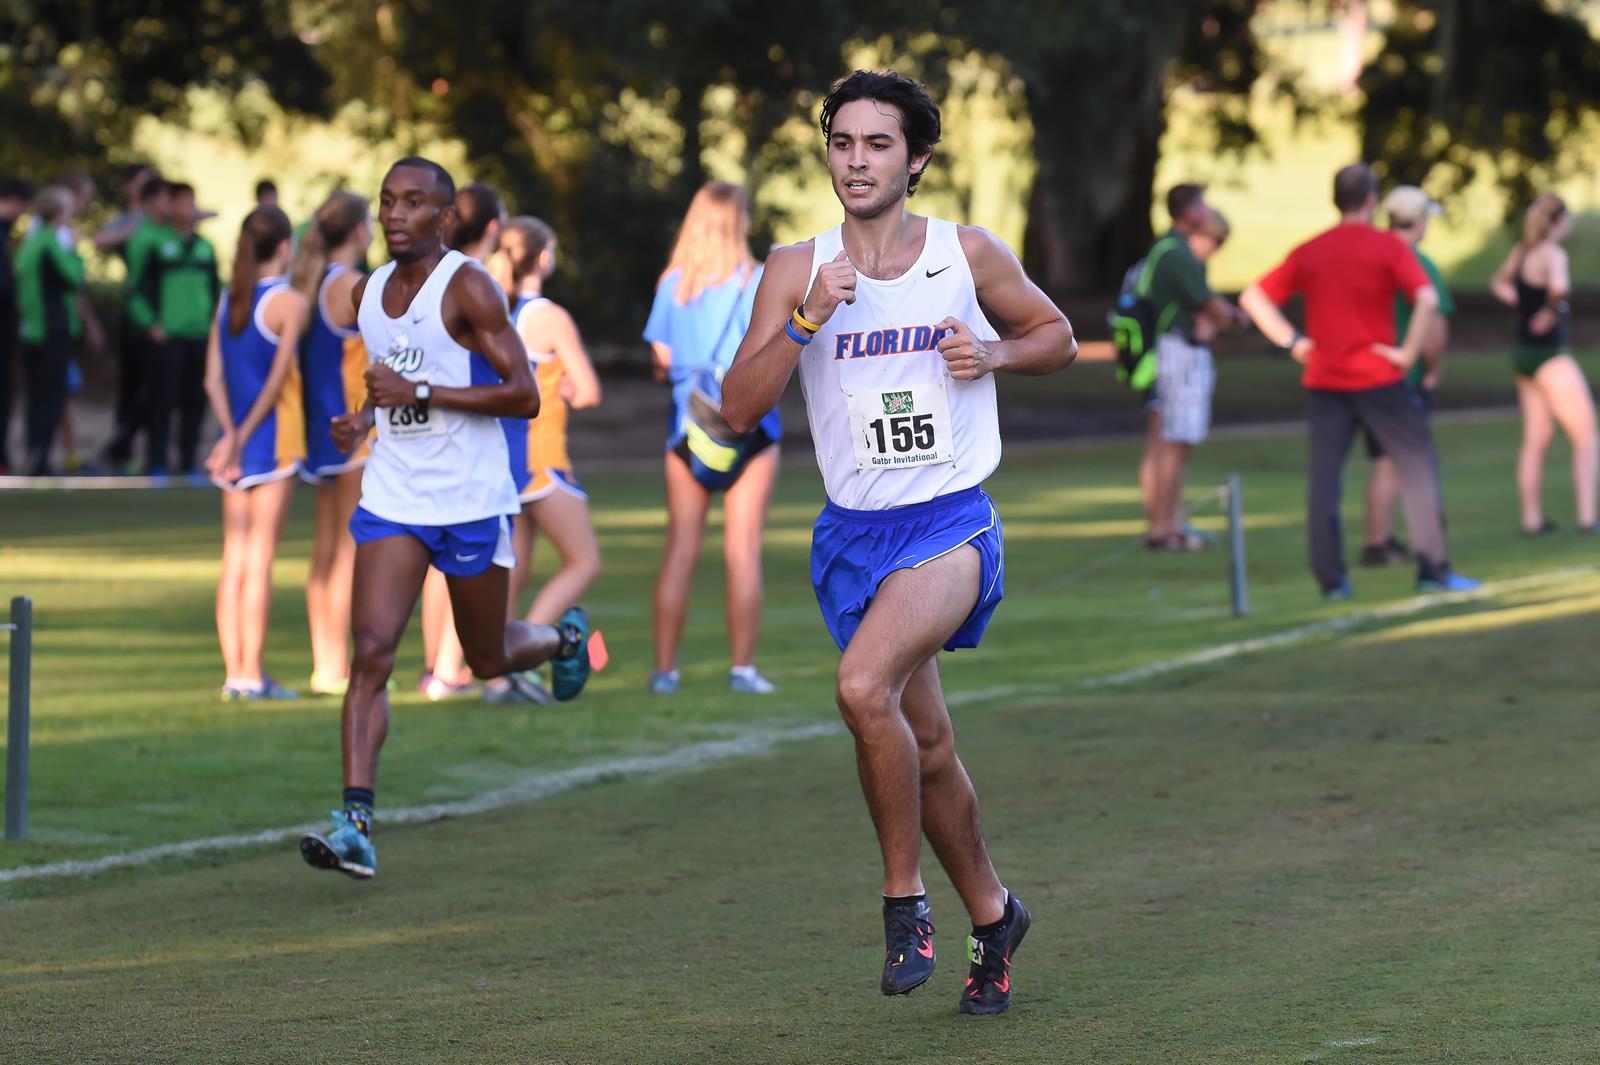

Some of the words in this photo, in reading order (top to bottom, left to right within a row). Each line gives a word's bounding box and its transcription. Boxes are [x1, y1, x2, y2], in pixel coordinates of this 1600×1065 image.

[869, 413, 935, 454] 155
[871, 456, 891, 465] Gator
[894, 452, 938, 464] Invitational
